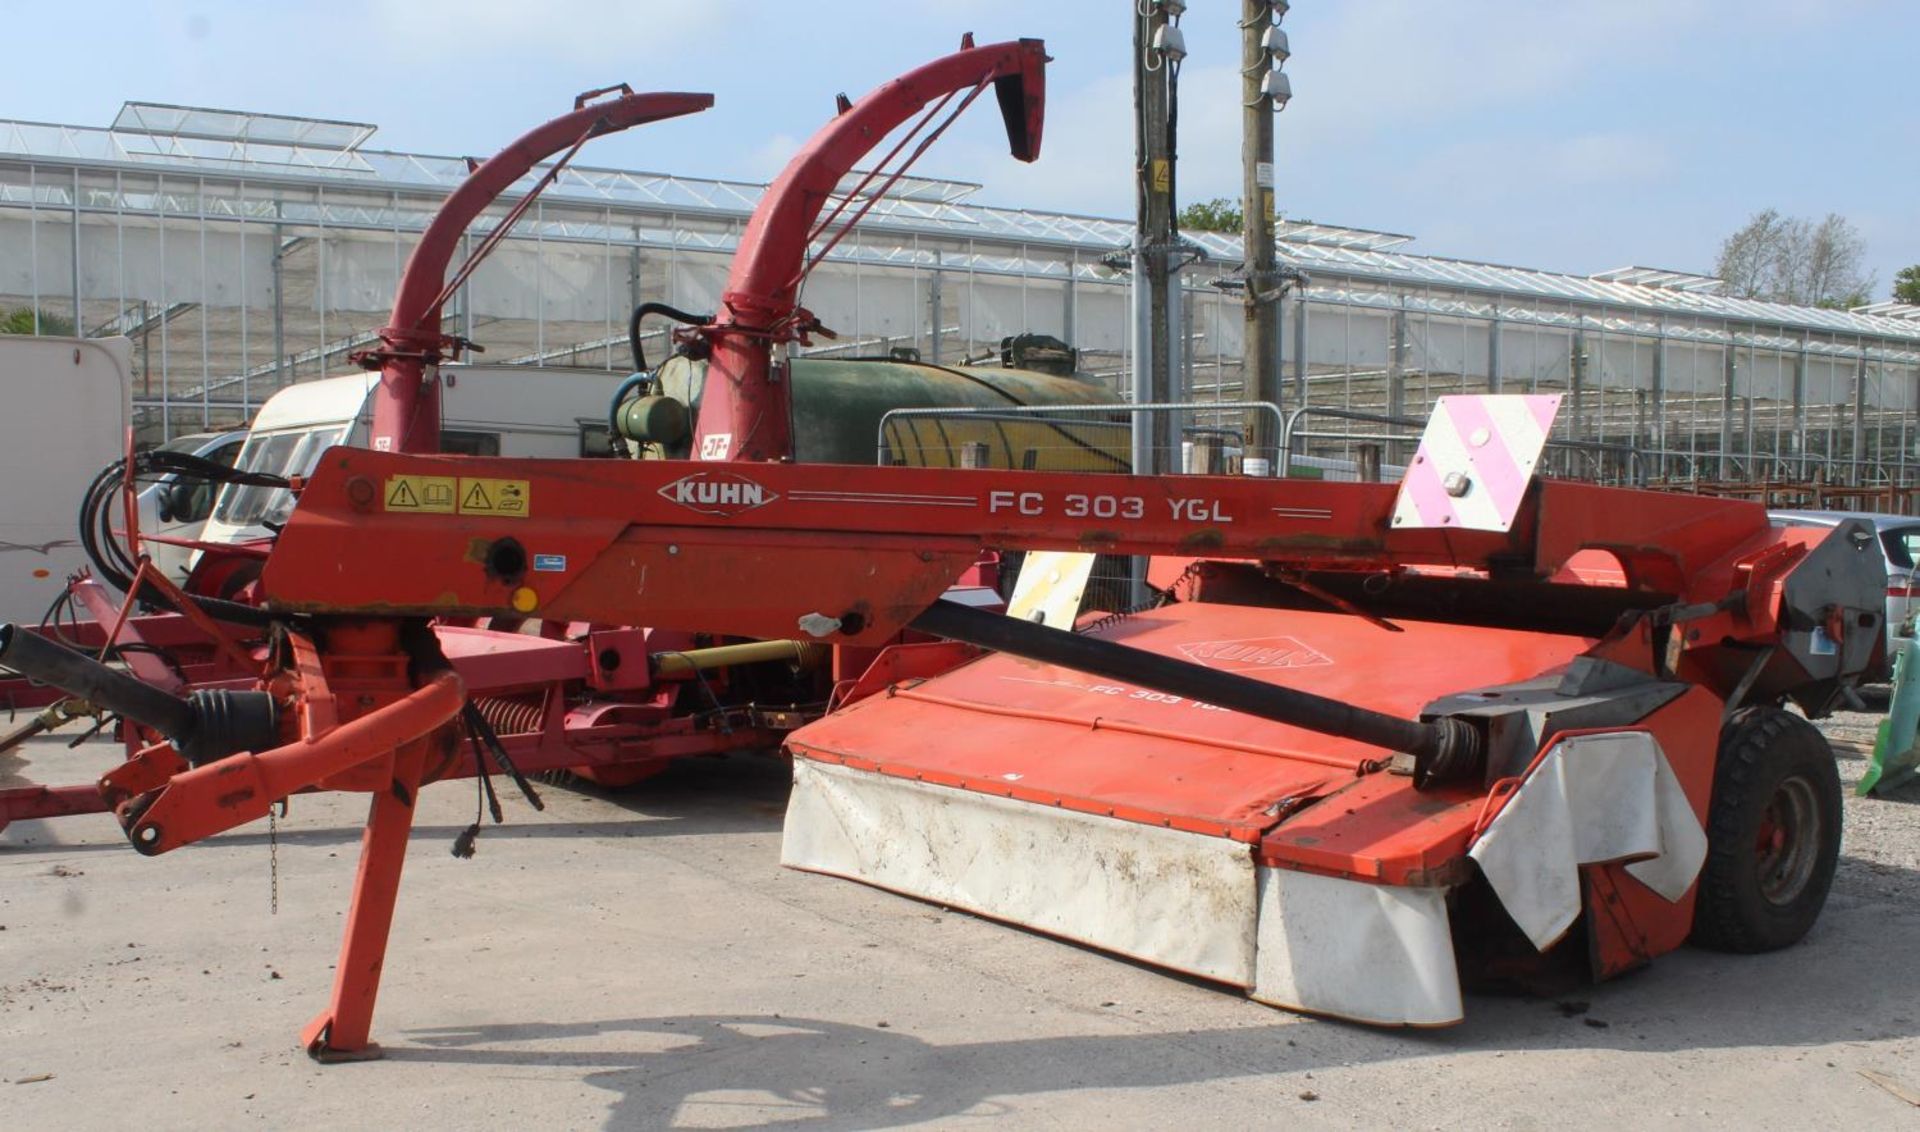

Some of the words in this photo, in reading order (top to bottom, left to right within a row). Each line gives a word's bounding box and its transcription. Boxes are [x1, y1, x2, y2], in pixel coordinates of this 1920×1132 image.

[676, 481, 762, 504] KUHN
[989, 490, 1044, 515] FC
[1064, 494, 1144, 519] 303
[1167, 497, 1233, 522] YGL
[1087, 684, 1125, 695] FC
[1128, 690, 1184, 704] 303
